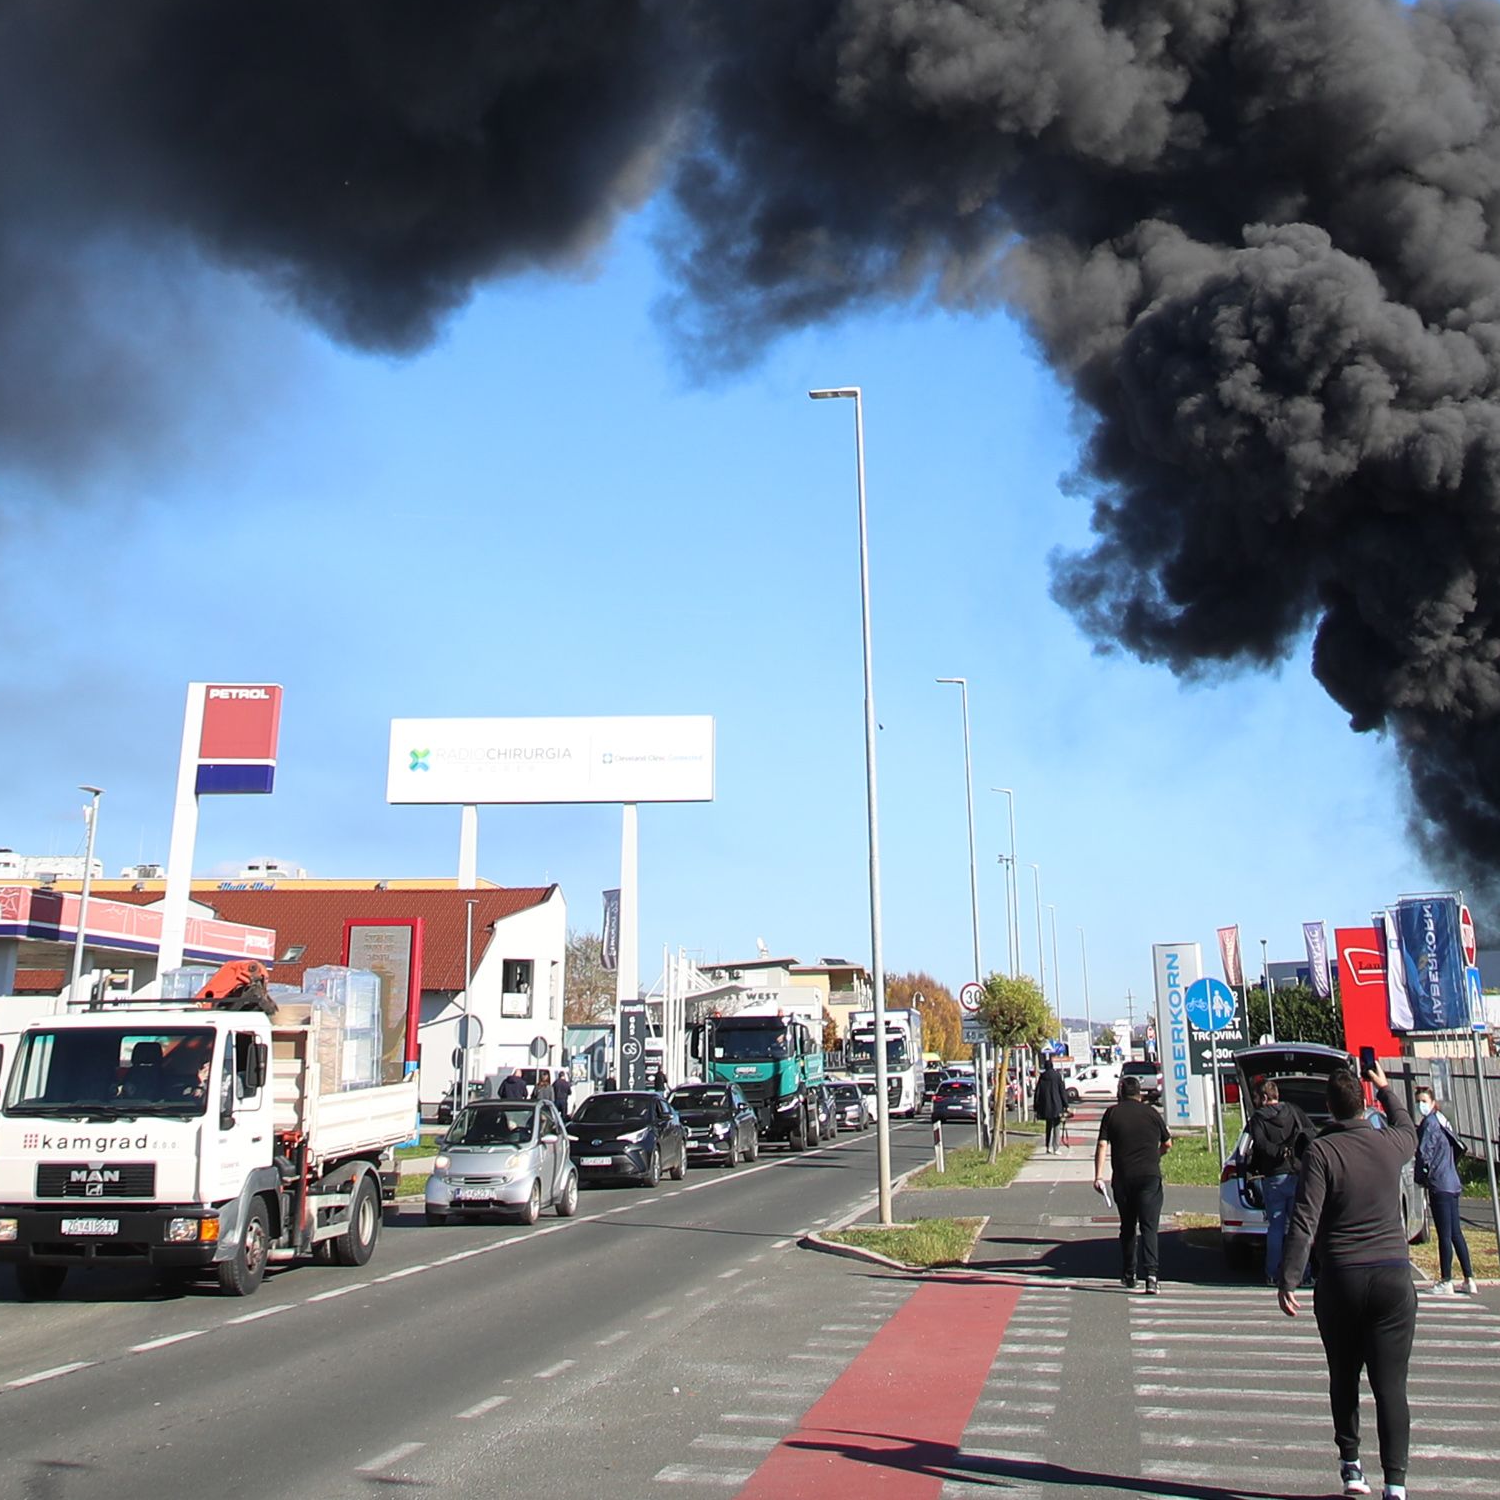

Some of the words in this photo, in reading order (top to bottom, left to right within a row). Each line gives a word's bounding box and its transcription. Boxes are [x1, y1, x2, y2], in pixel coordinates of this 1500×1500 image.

[209, 688, 270, 699] PETROL
[436, 747, 573, 760] RADIOCHIRURGIA
[746, 992, 779, 1001] WEST
[965, 989, 982, 1005] 30
[1165, 953, 1190, 1119] HABERKORN
[42, 1134, 148, 1152] kamgrad
[70, 1170, 120, 1182] MAN
